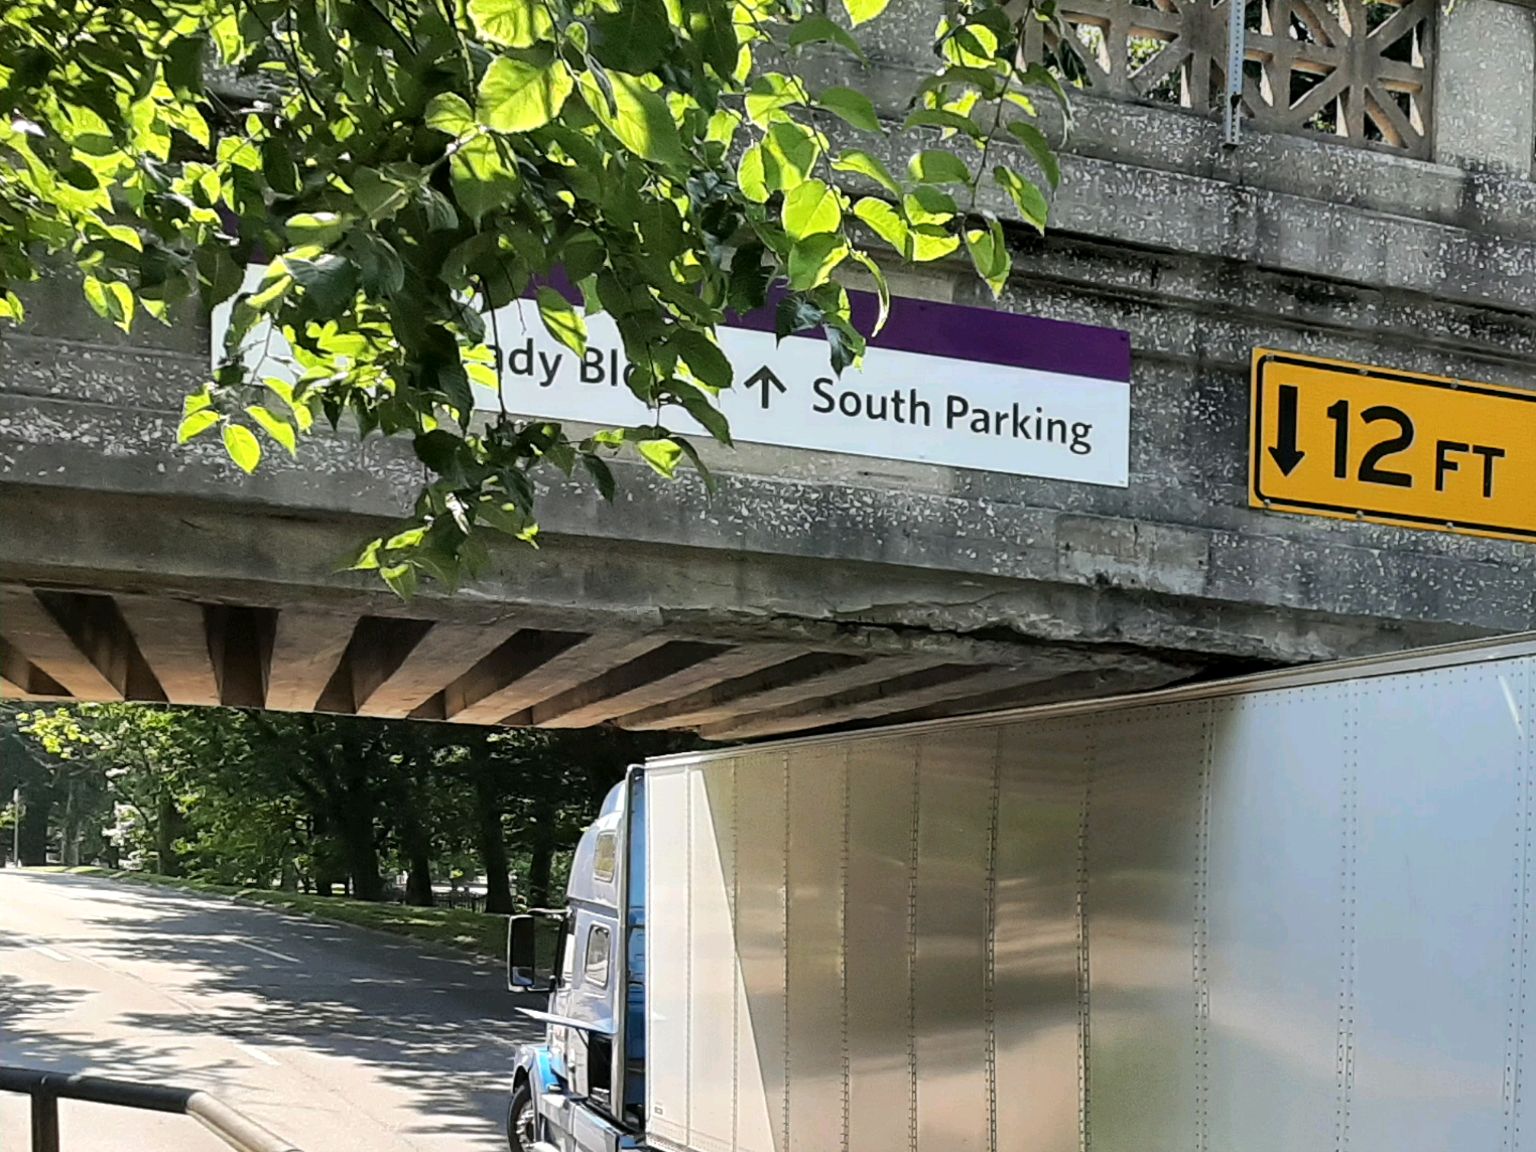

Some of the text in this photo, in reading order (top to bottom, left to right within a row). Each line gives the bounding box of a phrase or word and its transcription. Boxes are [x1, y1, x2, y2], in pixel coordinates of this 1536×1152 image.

[580, 346, 634, 387] Bl
[812, 377, 1093, 455] South Parking
[1327, 399, 1414, 488] 12
[1434, 439, 1505, 498] FT
